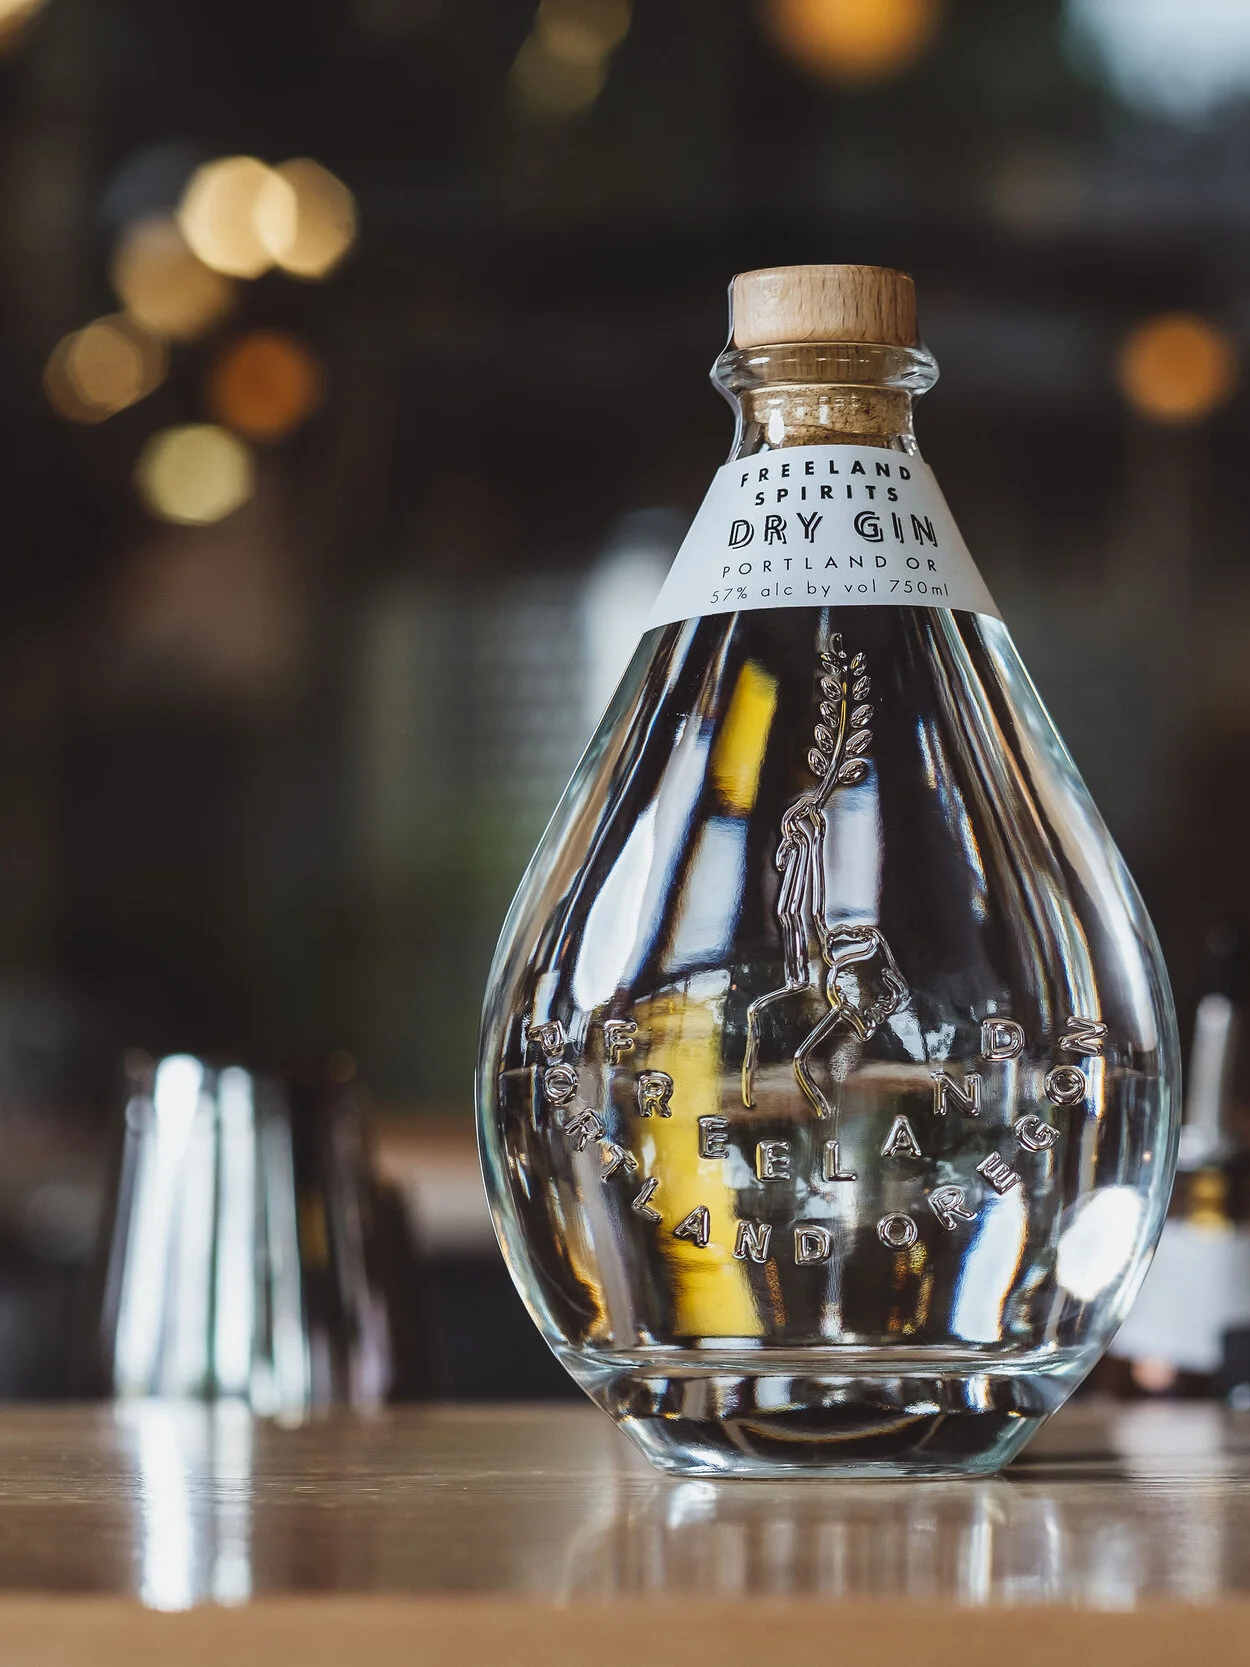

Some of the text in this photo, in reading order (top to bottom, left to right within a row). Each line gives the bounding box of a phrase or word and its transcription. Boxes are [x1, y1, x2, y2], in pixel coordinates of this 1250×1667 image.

[741, 460, 911, 487] FREELAND
[755, 485, 899, 506] SPIRITS
[728, 511, 938, 549] DRY GIN
[722, 555, 937, 578] PORTLAND OR
[710, 579, 950, 604] 57% alc by vol 750ml
[603, 1018, 1025, 1182] FREELAND
[528, 1015, 1109, 1266] PORTLAND OREGON
